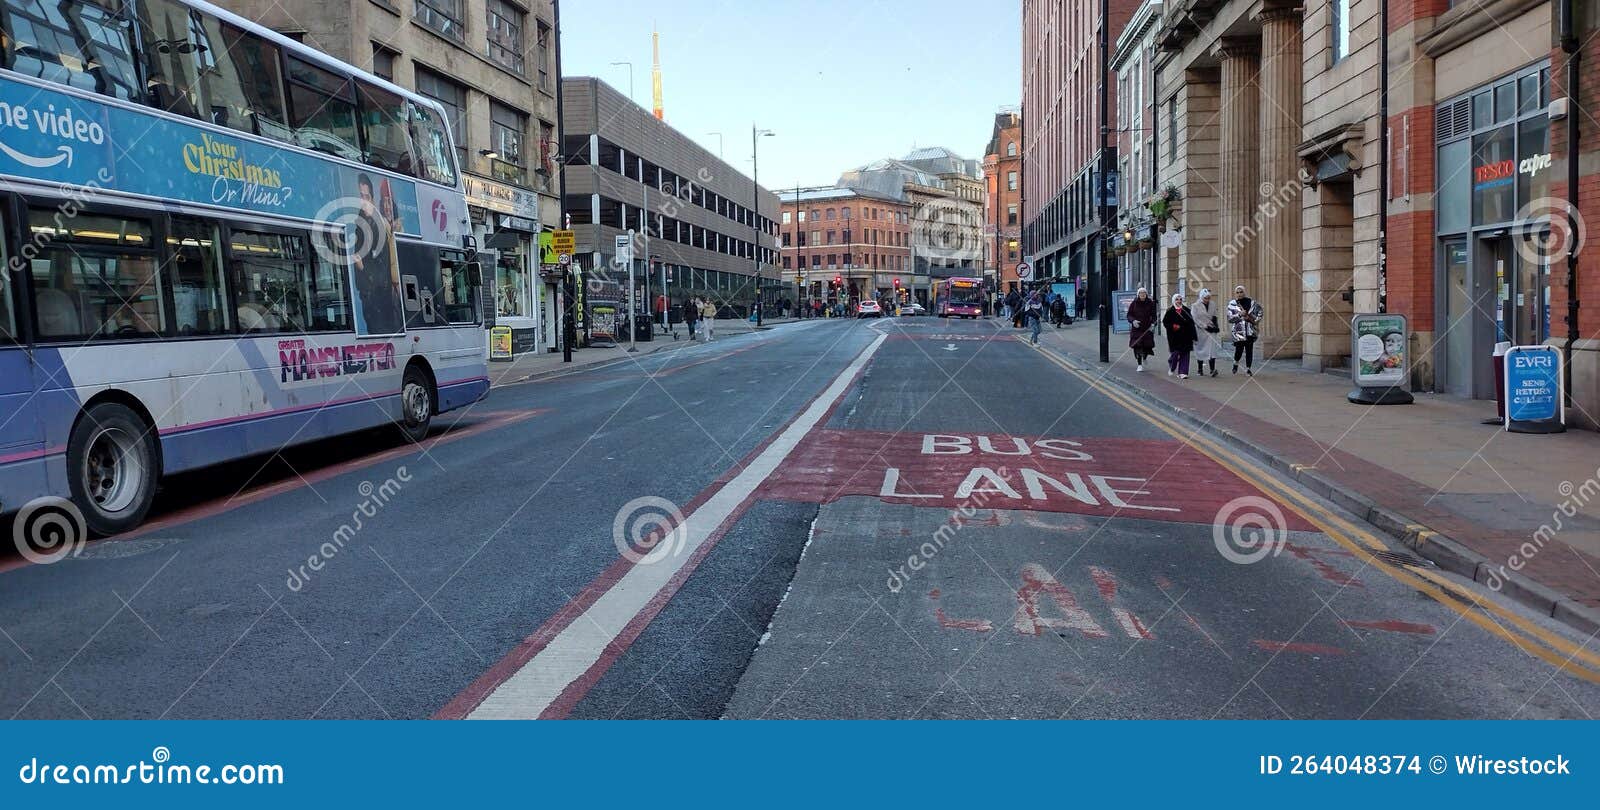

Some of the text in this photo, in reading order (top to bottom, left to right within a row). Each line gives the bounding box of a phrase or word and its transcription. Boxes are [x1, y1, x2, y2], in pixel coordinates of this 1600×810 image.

[33, 103, 104, 145] video
[201, 132, 237, 159] Your
[183, 143, 281, 188] Christmas
[1475, 153, 1551, 183] TESCO expre
[212, 175, 292, 208] Or Mine?
[278, 339, 304, 350] GREATER
[280, 342, 396, 383] MANCHESTER
[921, 434, 1095, 462] BUS
[880, 467, 1181, 512] LANE
